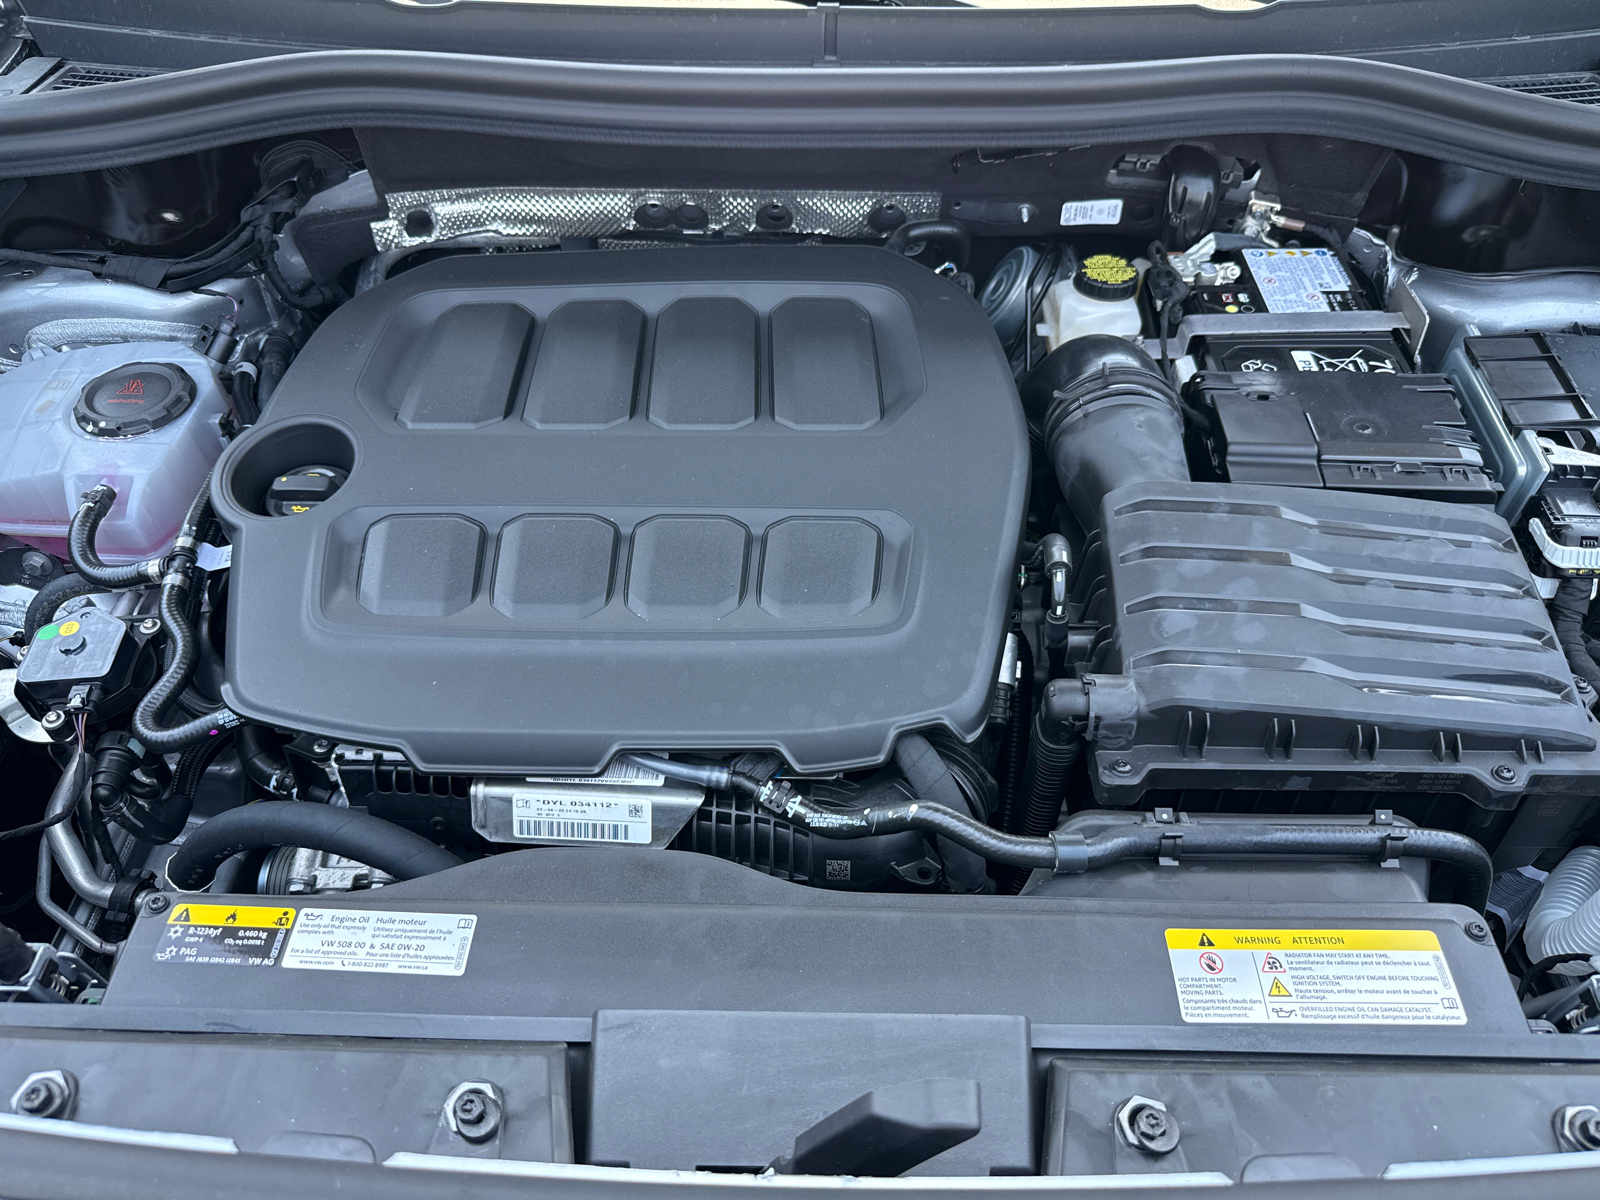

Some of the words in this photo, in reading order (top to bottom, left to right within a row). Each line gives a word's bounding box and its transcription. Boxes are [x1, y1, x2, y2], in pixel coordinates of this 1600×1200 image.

[330, 915, 357, 924] Engine
[358, 916, 370, 924] Oil
[376, 916, 396, 924] Huile
[188, 927, 222, 937] R-1234yf
[259, 930, 268, 938] kg
[1234, 936, 1281, 944] WARNING
[1292, 936, 1345, 944] ATTENTION
[397, 944, 425, 952] 0W-20
[248, 957, 262, 965] VW
[262, 958, 275, 966] AG
